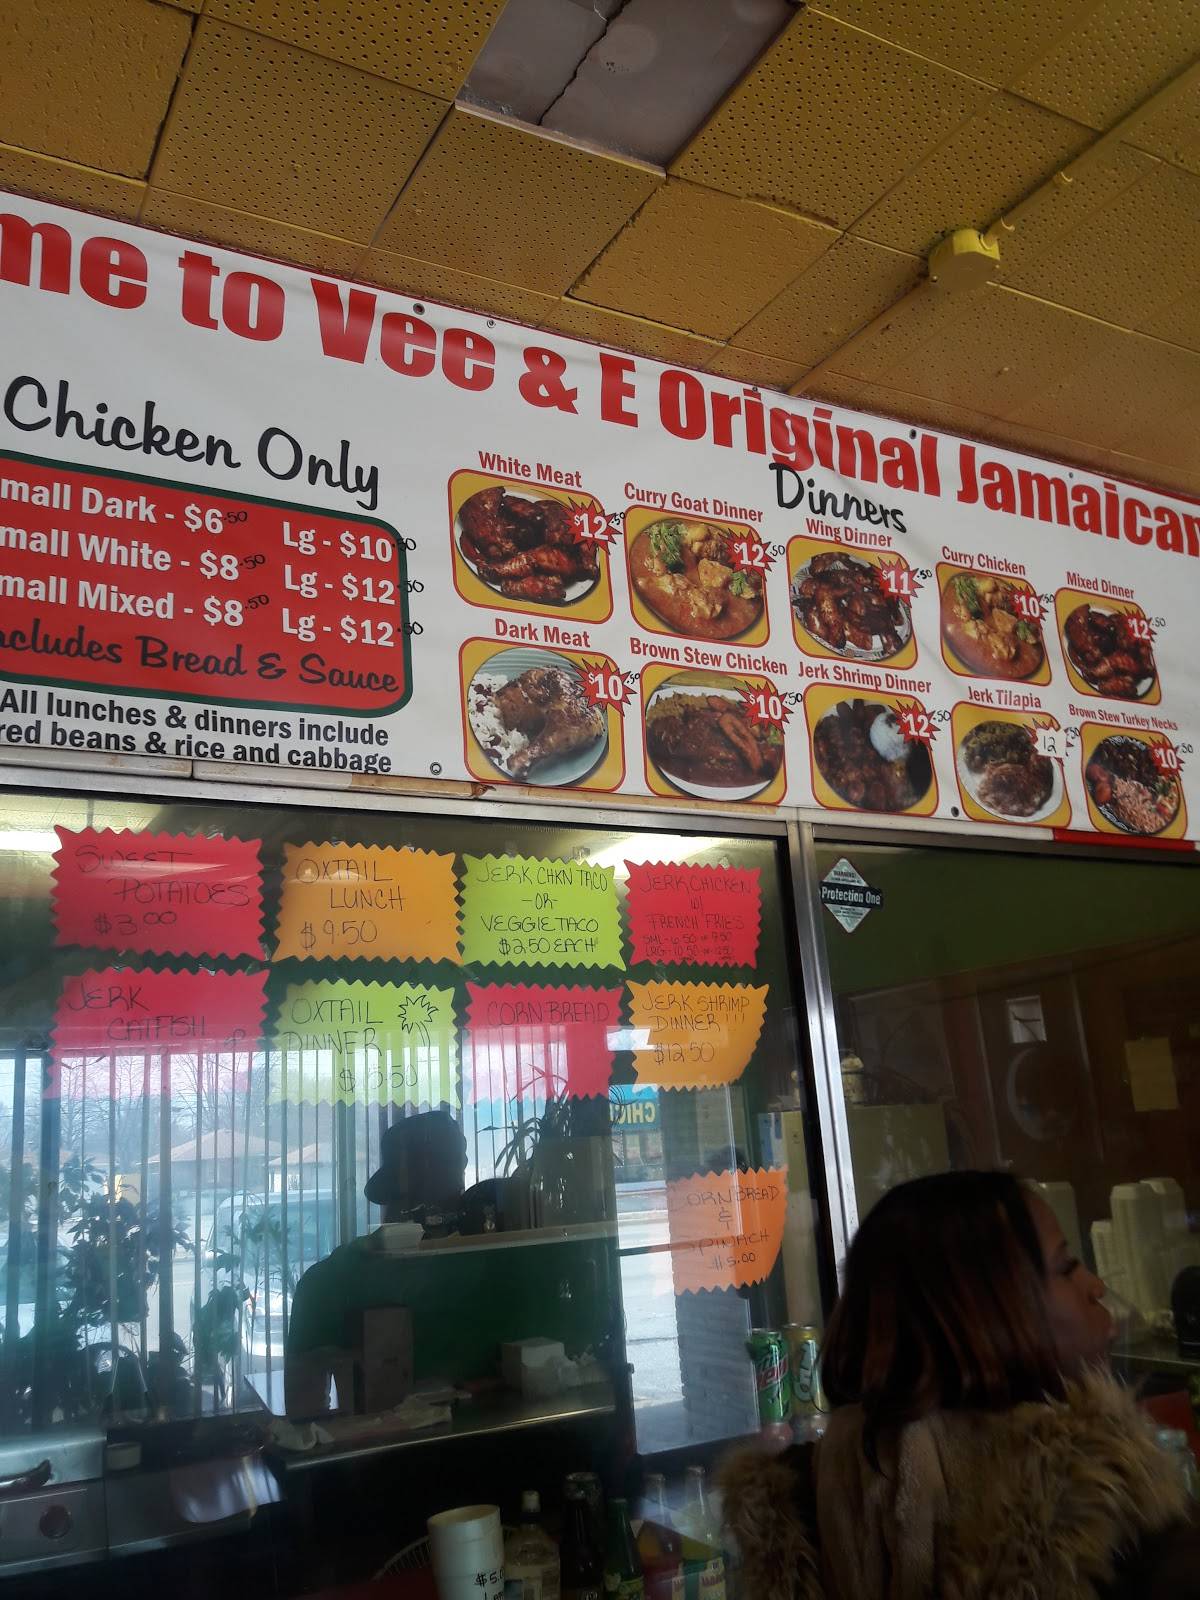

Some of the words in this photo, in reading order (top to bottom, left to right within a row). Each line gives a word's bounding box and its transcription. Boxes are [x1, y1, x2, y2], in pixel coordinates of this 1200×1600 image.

[178, 249, 286, 342] to
[310, 277, 496, 392] Vee
[518, 346, 579, 415] &
[599, 352, 639, 428] E
[658, 369, 941, 498] Original
[4, 375, 242, 469] Chicken
[257, 427, 379, 511] Only
[478, 450, 532, 479] White
[536, 462, 584, 489] Meat
[0, 477, 72, 511] mall
[81, 486, 158, 524] Dark
[623, 481, 668, 510] Curry
[671, 490, 709, 515] Goat
[712, 497, 765, 524] Dinner
[768, 462, 908, 534] Dinners
[282, 520, 317, 556] Lg
[804, 516, 843, 544] Wing
[843, 524, 893, 548] Dinner
[78, 532, 172, 572] White
[941, 545, 976, 569] Curry
[976, 552, 1027, 577] Chicken
[284, 563, 319, 600] Lg
[1065, 570, 1099, 593] Mixed
[1100, 578, 1136, 601] Dinner
[78, 579, 175, 620] Mixed
[282, 607, 317, 644] Lg
[495, 617, 540, 642] Dark
[543, 624, 592, 649] Meat
[134, 635, 248, 677] Bread
[256, 651, 288, 681] &
[298, 652, 400, 694] Sauce
[629, 636, 681, 662] Brown
[683, 645, 723, 669] Stew
[725, 651, 788, 677] Chicken
[798, 660, 831, 681] Jerk
[833, 664, 883, 691] Shrimp
[885, 672, 933, 694] Dinner
[968, 685, 993, 705] Jerk
[995, 688, 1042, 714] Tilapia
[0, 688, 38, 715] All
[47, 691, 158, 728] lunches
[164, 704, 188, 730] &
[194, 709, 292, 741] dinners
[299, 717, 390, 747] include
[1068, 703, 1098, 721] Brown
[1098, 708, 1121, 724] Stew
[1120, 712, 1151, 731] Turkey
[1150, 717, 1179, 732] Necks
[51, 720, 138, 752] beans
[144, 731, 168, 756] &
[174, 733, 226, 760] rice
[232, 742, 280, 765] and
[287, 745, 393, 776] cabbage
[296, 858, 393, 884] OXTAIL
[476, 861, 533, 885] JERK
[536, 866, 573, 886] CHKN
[575, 868, 609, 892] TACO
[640, 871, 689, 895] JERK
[105, 877, 250, 906] POTATOES
[330, 885, 407, 912] LUNCH
[820, 886, 864, 904] Protection
[865, 890, 881, 906] One
[480, 914, 557, 933] VEGGIE
[555, 916, 599, 933] TACO
[67, 980, 150, 1012] JERK
[291, 998, 384, 1025] OXTAIL
[641, 990, 694, 1013] JERK
[697, 994, 750, 1014] SHRIMP
[107, 1015, 206, 1041] CATFISH
[648, 1013, 721, 1033] DINNER
[282, 1027, 383, 1057] DINNER
